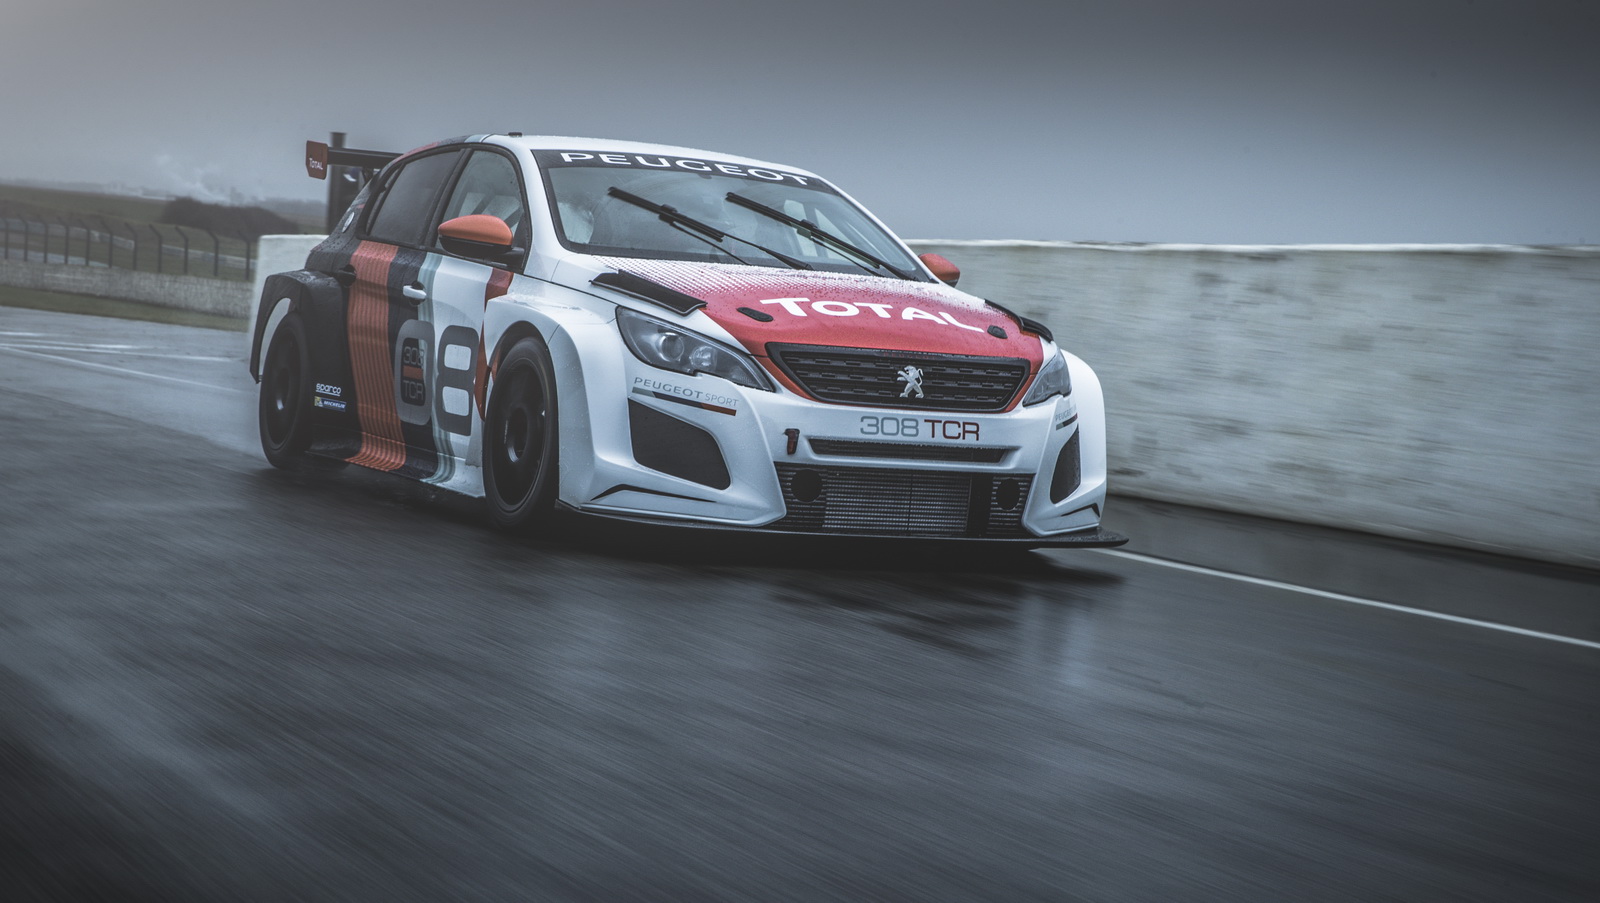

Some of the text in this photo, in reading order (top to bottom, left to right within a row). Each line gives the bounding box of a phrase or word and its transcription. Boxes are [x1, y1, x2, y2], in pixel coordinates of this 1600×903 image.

[309, 157, 324, 170] TOTAL
[559, 152, 808, 186] PEUGEOT
[759, 297, 985, 333] TOTAL
[315, 383, 342, 395] sparco
[403, 380, 424, 400] TCR
[633, 376, 740, 407] PEUGEOT SPORT
[860, 415, 980, 441] 308 TCR
